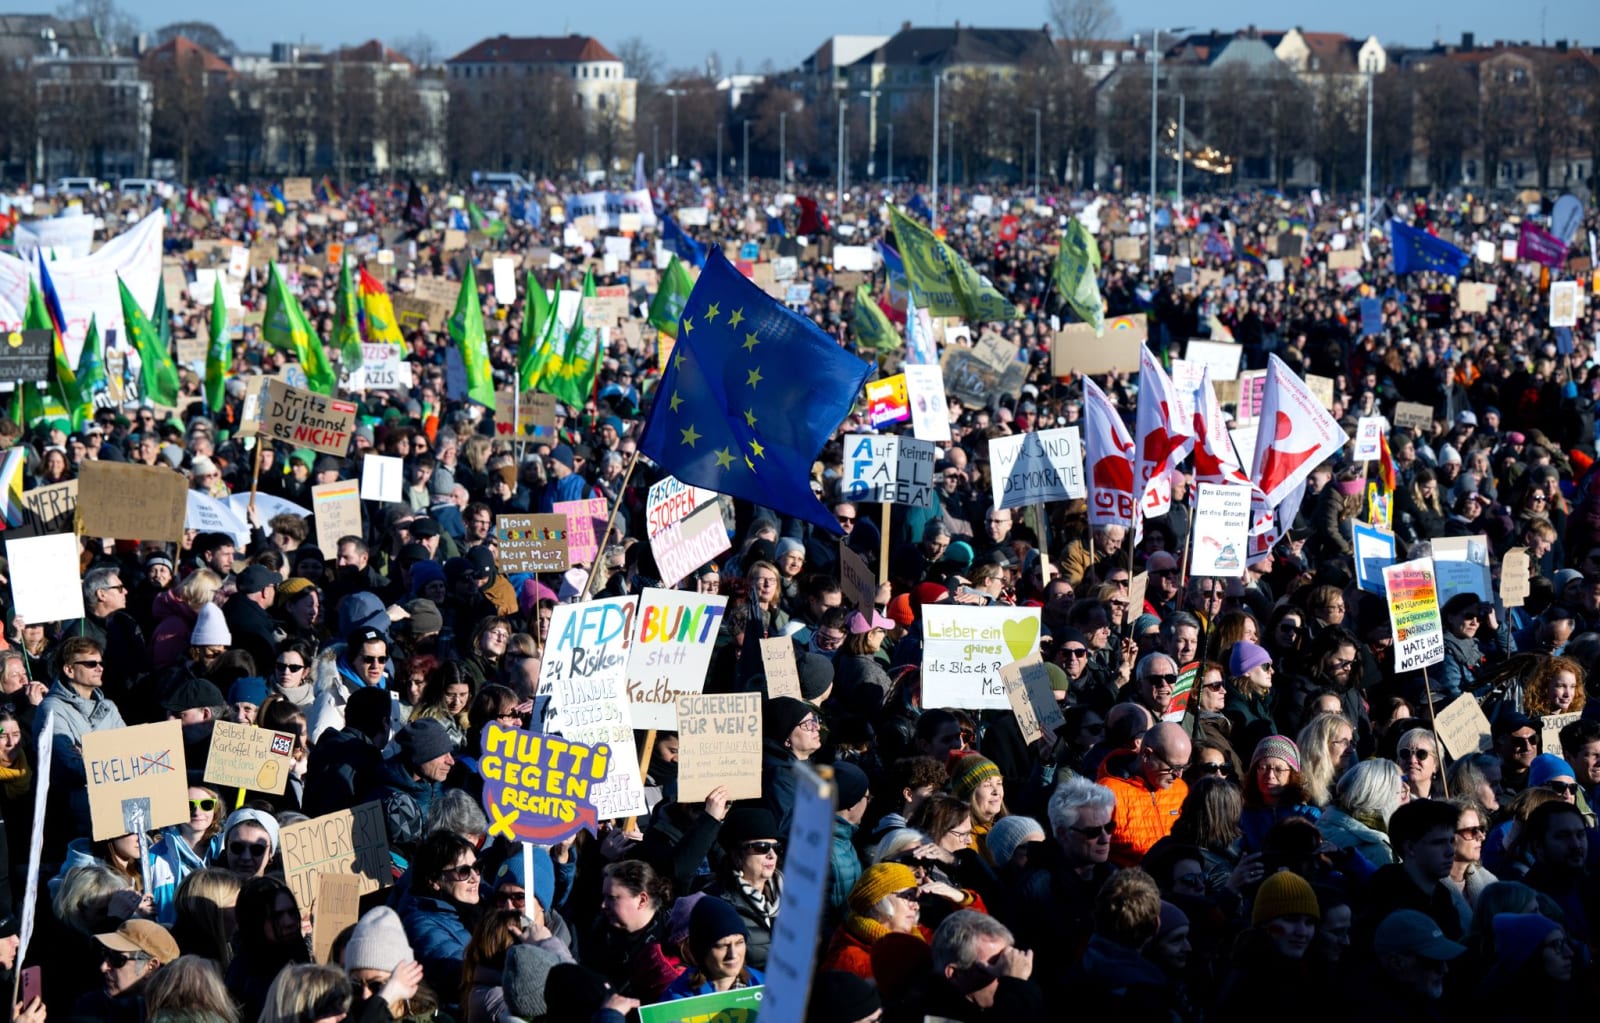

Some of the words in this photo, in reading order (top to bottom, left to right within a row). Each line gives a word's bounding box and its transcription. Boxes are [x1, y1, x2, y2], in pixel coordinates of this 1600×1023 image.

[283, 389, 326, 414] Fritz
[272, 402, 297, 422] DU
[301, 411, 347, 432] kannst
[273, 423, 292, 438] es
[293, 425, 347, 448] NICHT
[900, 440, 934, 462] keinen
[997, 444, 1032, 465] WIR
[1035, 438, 1070, 457] SIND
[853, 460, 927, 487] FALL
[1002, 466, 1080, 493] DEMOKRATIE
[649, 486, 696, 536] STOPPEN
[500, 517, 531, 529] Mein
[531, 550, 562, 560] Merz
[557, 602, 635, 651] AFD?
[640, 603, 726, 644] BUNT
[928, 619, 978, 639] Lieber
[981, 626, 1001, 639] ein
[1403, 638, 1425, 655] HATE
[1427, 634, 1439, 648] HAS
[569, 644, 625, 678] Risiken
[646, 646, 687, 666] statt
[929, 660, 945, 672] als
[949, 661, 987, 673] Black
[1401, 657, 1413, 670] NO
[1414, 651, 1431, 665] PLACE
[626, 678, 702, 704] Kackbr
[982, 677, 1006, 695] Mer
[679, 694, 761, 716] SICHERHEIT
[215, 722, 246, 740] Selbst
[249, 729, 264, 743] die
[680, 716, 707, 736] FÜR
[213, 737, 250, 757] Kartoffel
[256, 744, 268, 759] hat
[272, 743, 290, 753] NZS
[274, 737, 291, 747] FCK
[481, 755, 588, 799] GEGEN
[501, 786, 577, 823] RECHTS
[284, 805, 381, 872] REMIGRIERT
